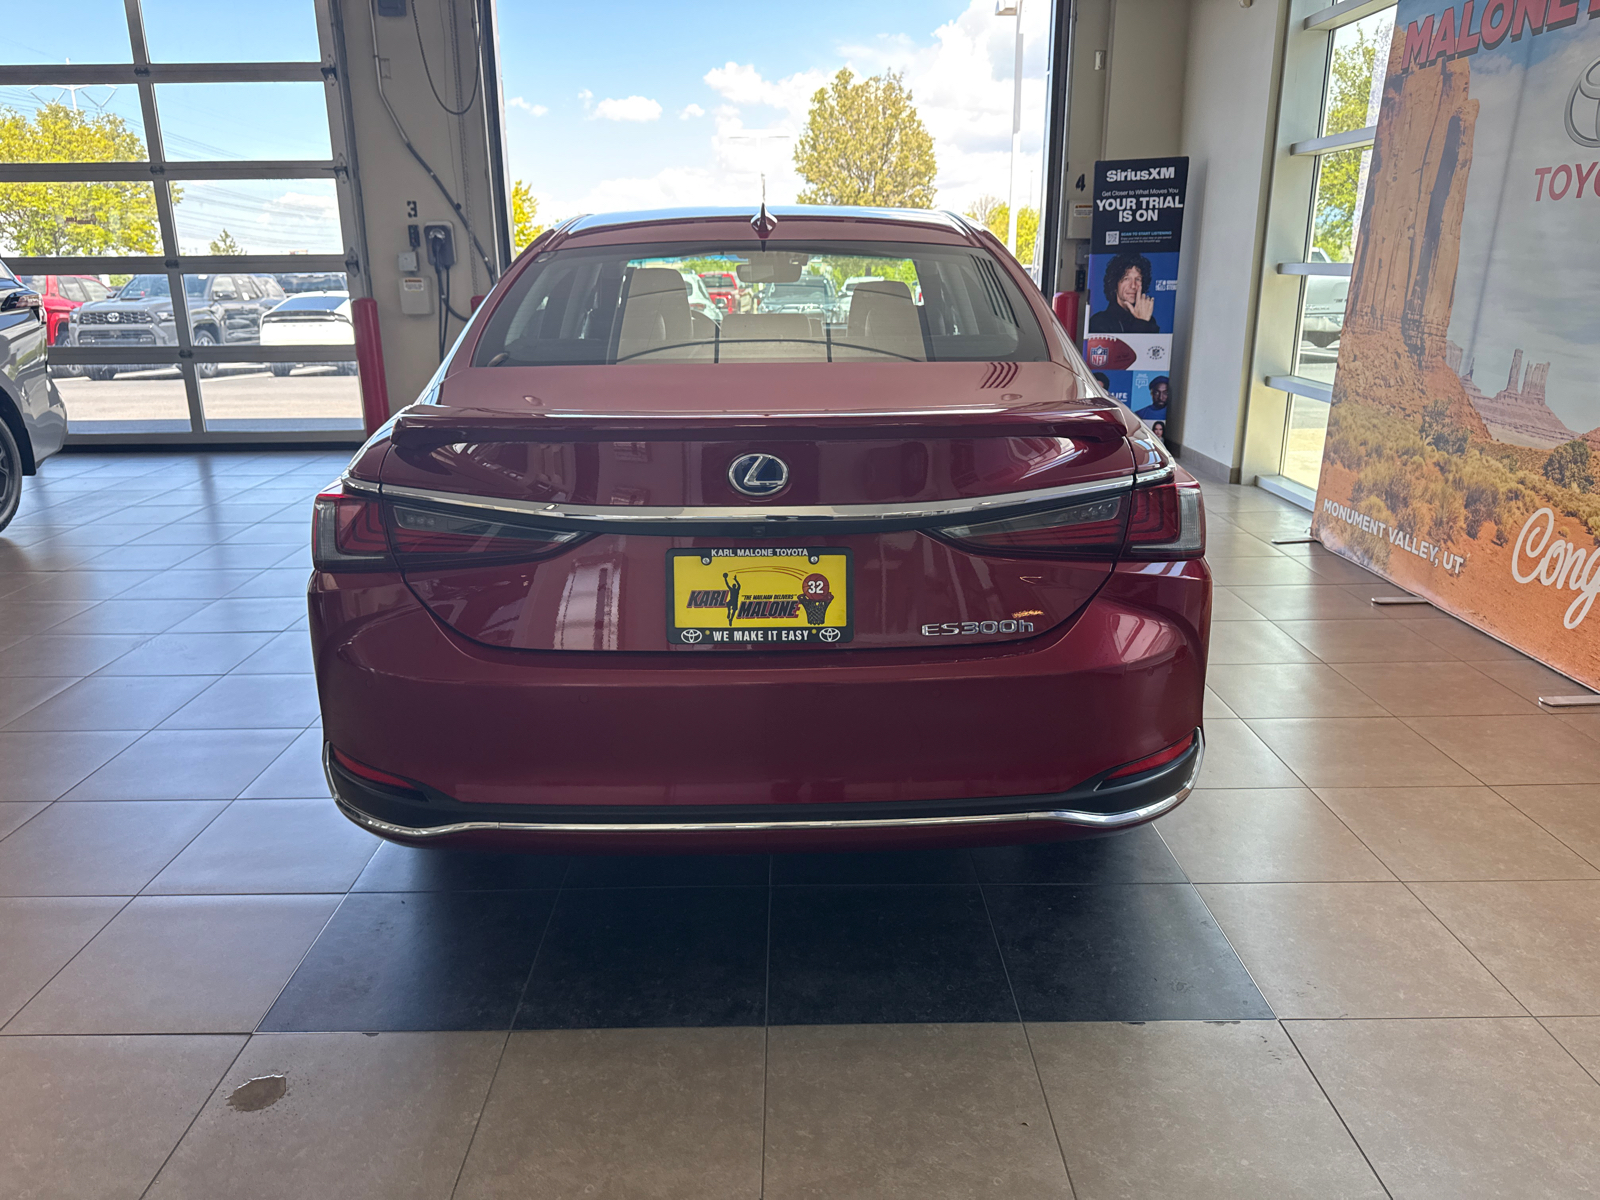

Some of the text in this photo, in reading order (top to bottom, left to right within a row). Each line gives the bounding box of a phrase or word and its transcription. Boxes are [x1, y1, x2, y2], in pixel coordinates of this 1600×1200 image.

[1075, 173, 1086, 192] 4
[1106, 167, 1175, 182] SiriusXM
[406, 200, 418, 218] 3
[1096, 196, 1184, 212] YOUR TRIAL
[1118, 209, 1159, 222] IS ON
[1323, 498, 1464, 574] MONUMENT VALLEY, UT
[711, 548, 808, 557] KARL MALONE TOYOTA
[807, 580, 824, 594] 32
[686, 590, 729, 609] KARL
[736, 600, 800, 619] MALONE
[713, 630, 809, 641] WE MAKE IT EASY
[921, 619, 1034, 636] ES300h
